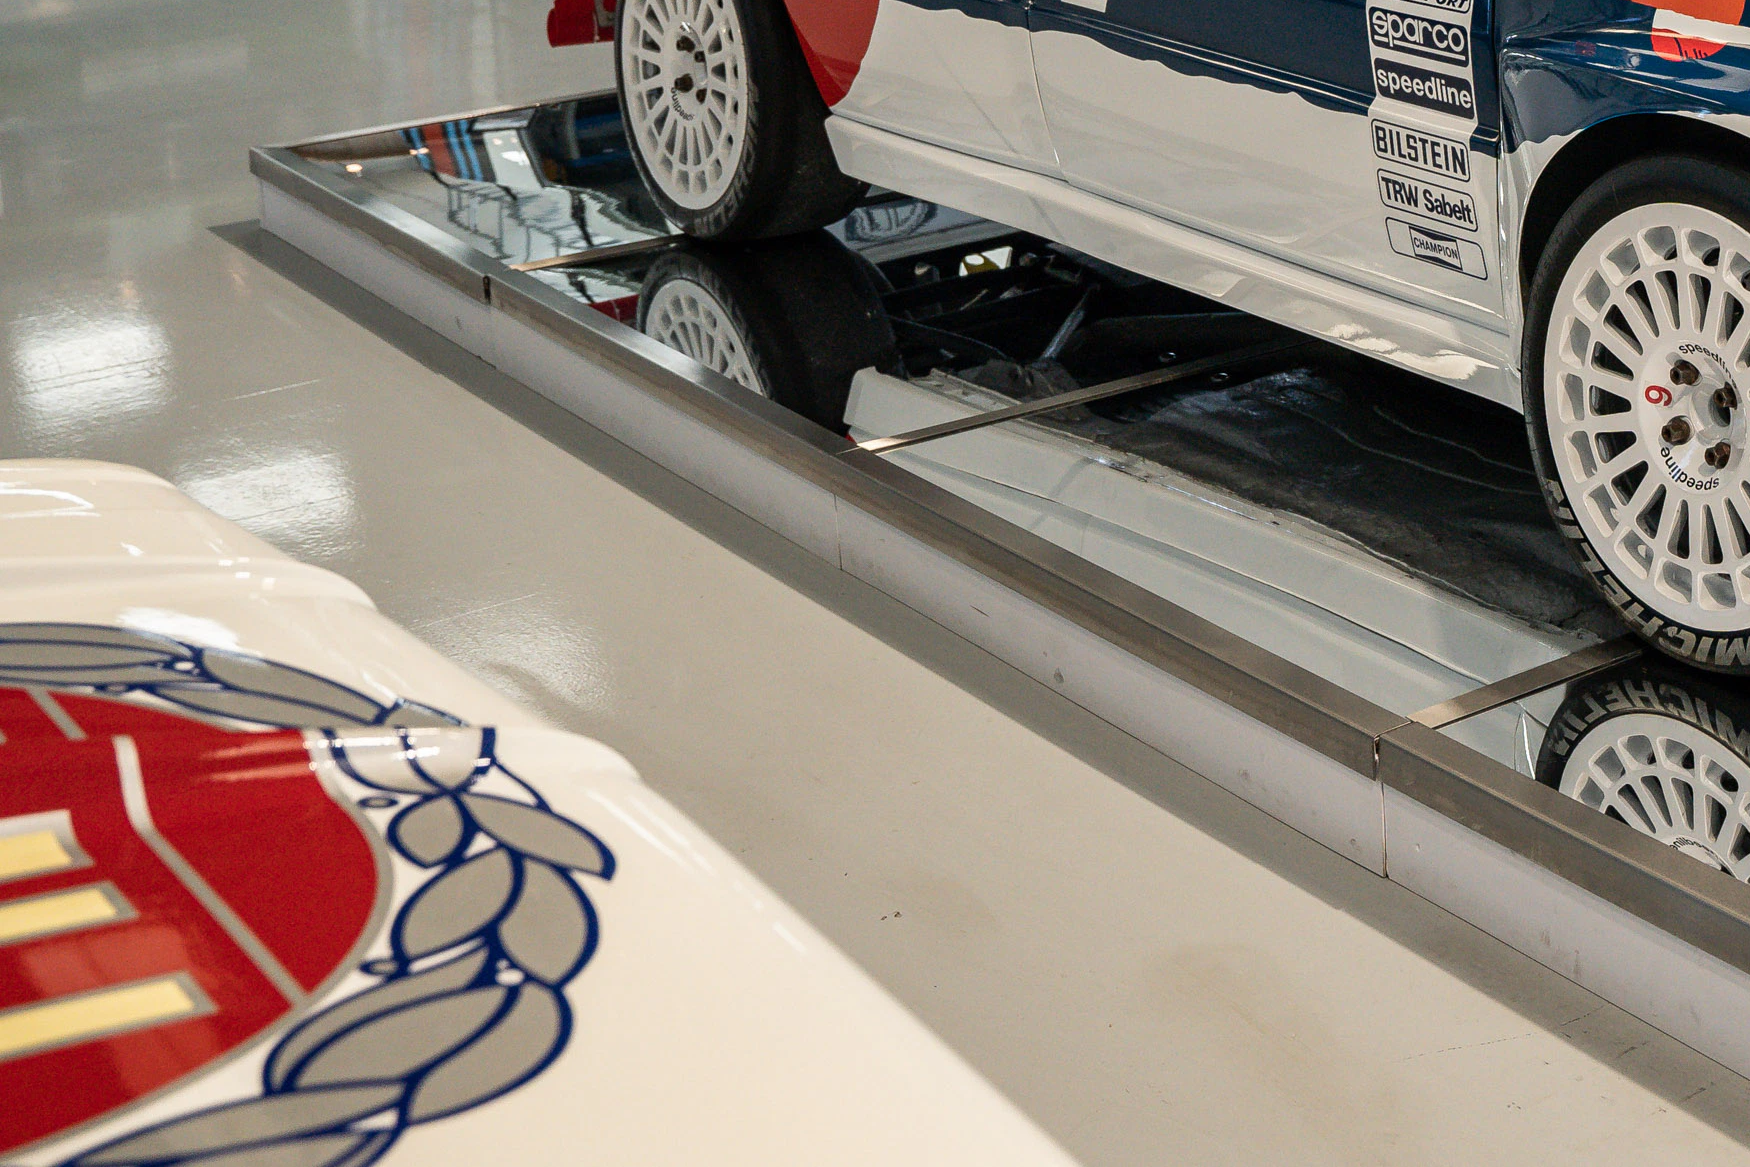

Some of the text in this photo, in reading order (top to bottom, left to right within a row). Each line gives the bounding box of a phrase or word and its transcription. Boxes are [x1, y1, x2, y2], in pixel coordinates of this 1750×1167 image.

[1372, 10, 1466, 61] sparco
[1377, 68, 1472, 109] speedline
[1375, 124, 1467, 176] BILSTEIN
[1381, 176, 1474, 225] TRW Sabelt
[1413, 236, 1459, 261] CHAMPION
[1661, 446, 1720, 491] speedline
